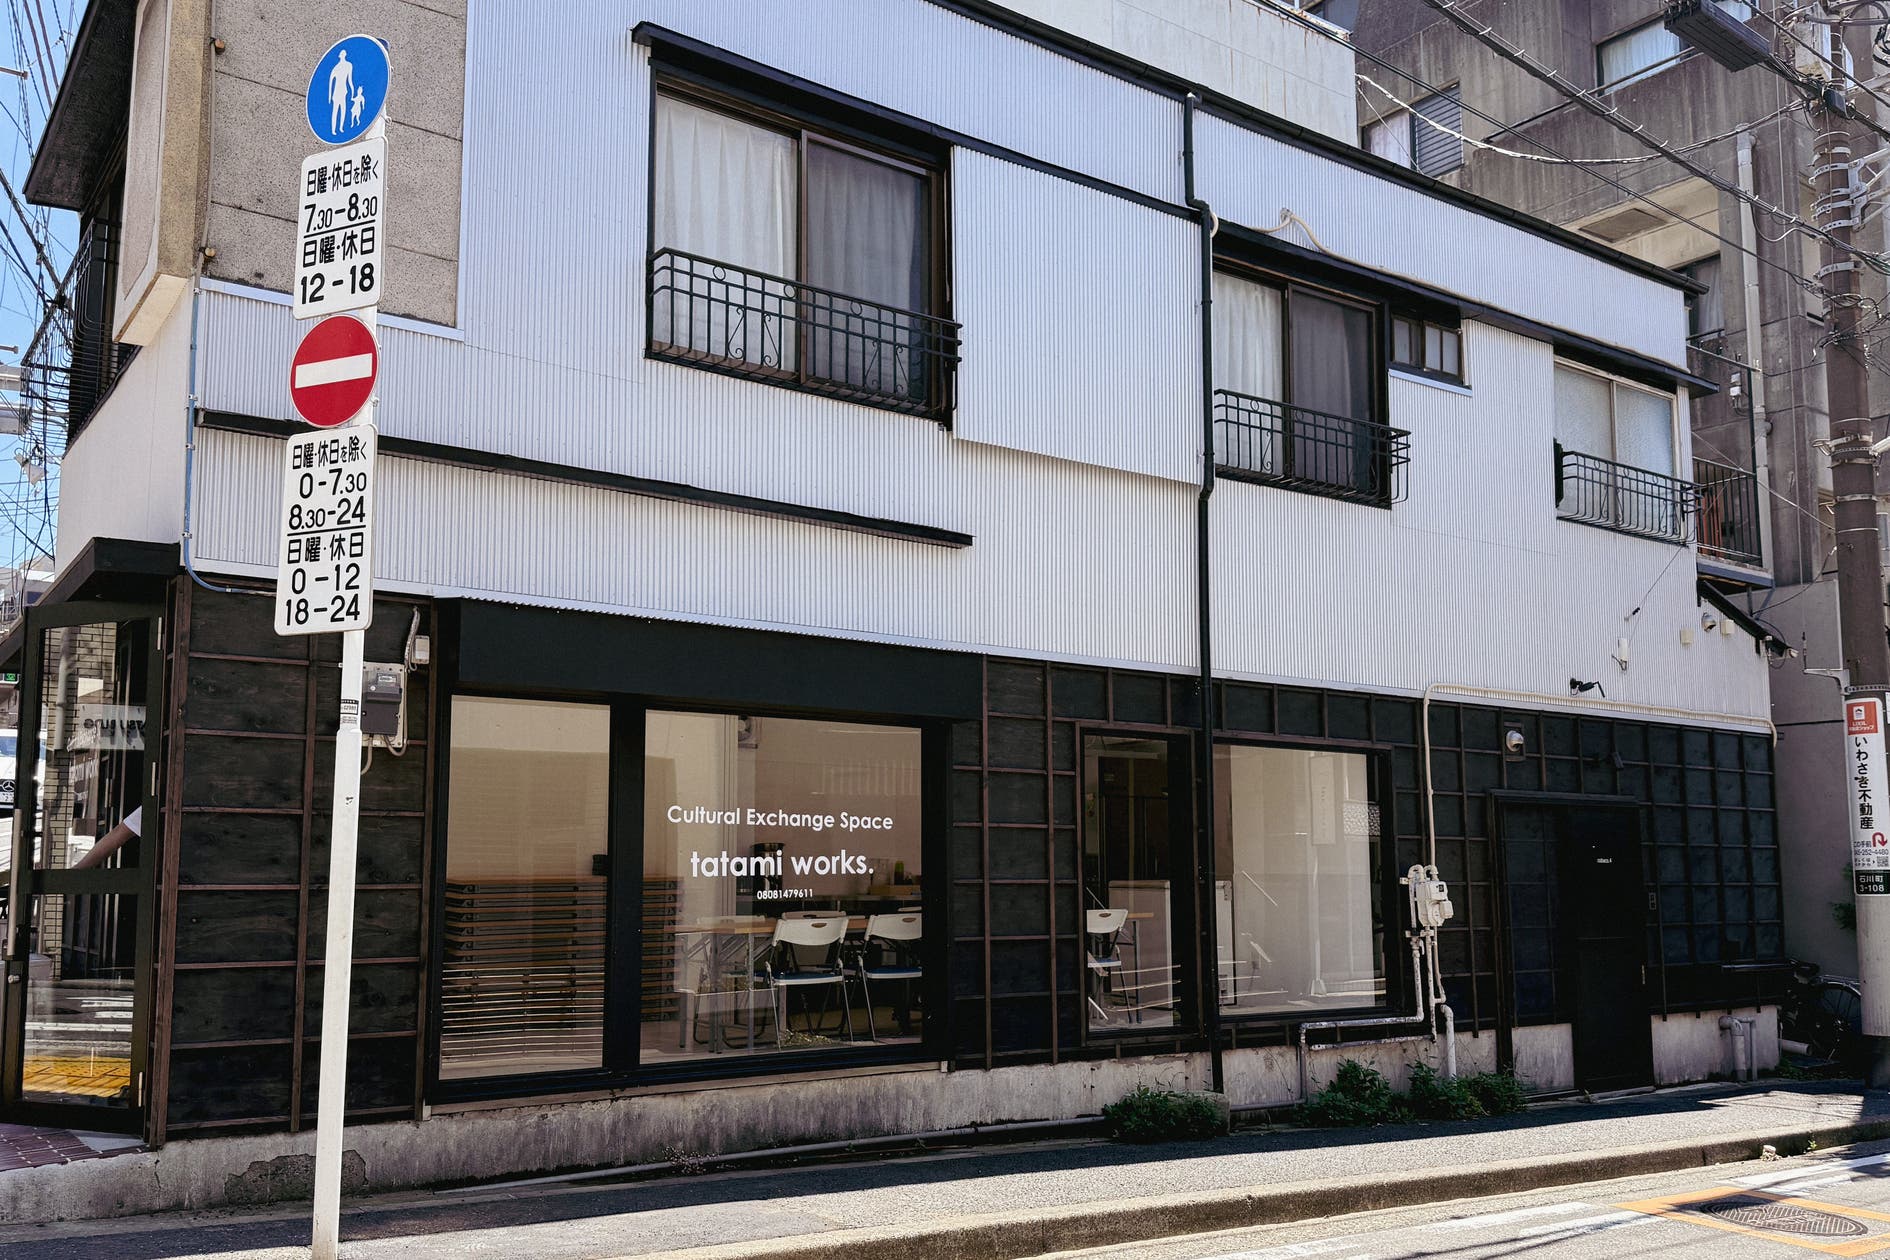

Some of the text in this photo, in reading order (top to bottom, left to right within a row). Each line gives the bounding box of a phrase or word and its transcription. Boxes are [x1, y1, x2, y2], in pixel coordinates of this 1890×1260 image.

[1855, 736, 1874, 830] いわさき不動産
[667, 805, 894, 832] Cultural Exchange Space
[690, 849, 875, 878] tatami works.
[756, 888, 814, 900] 08081479611
